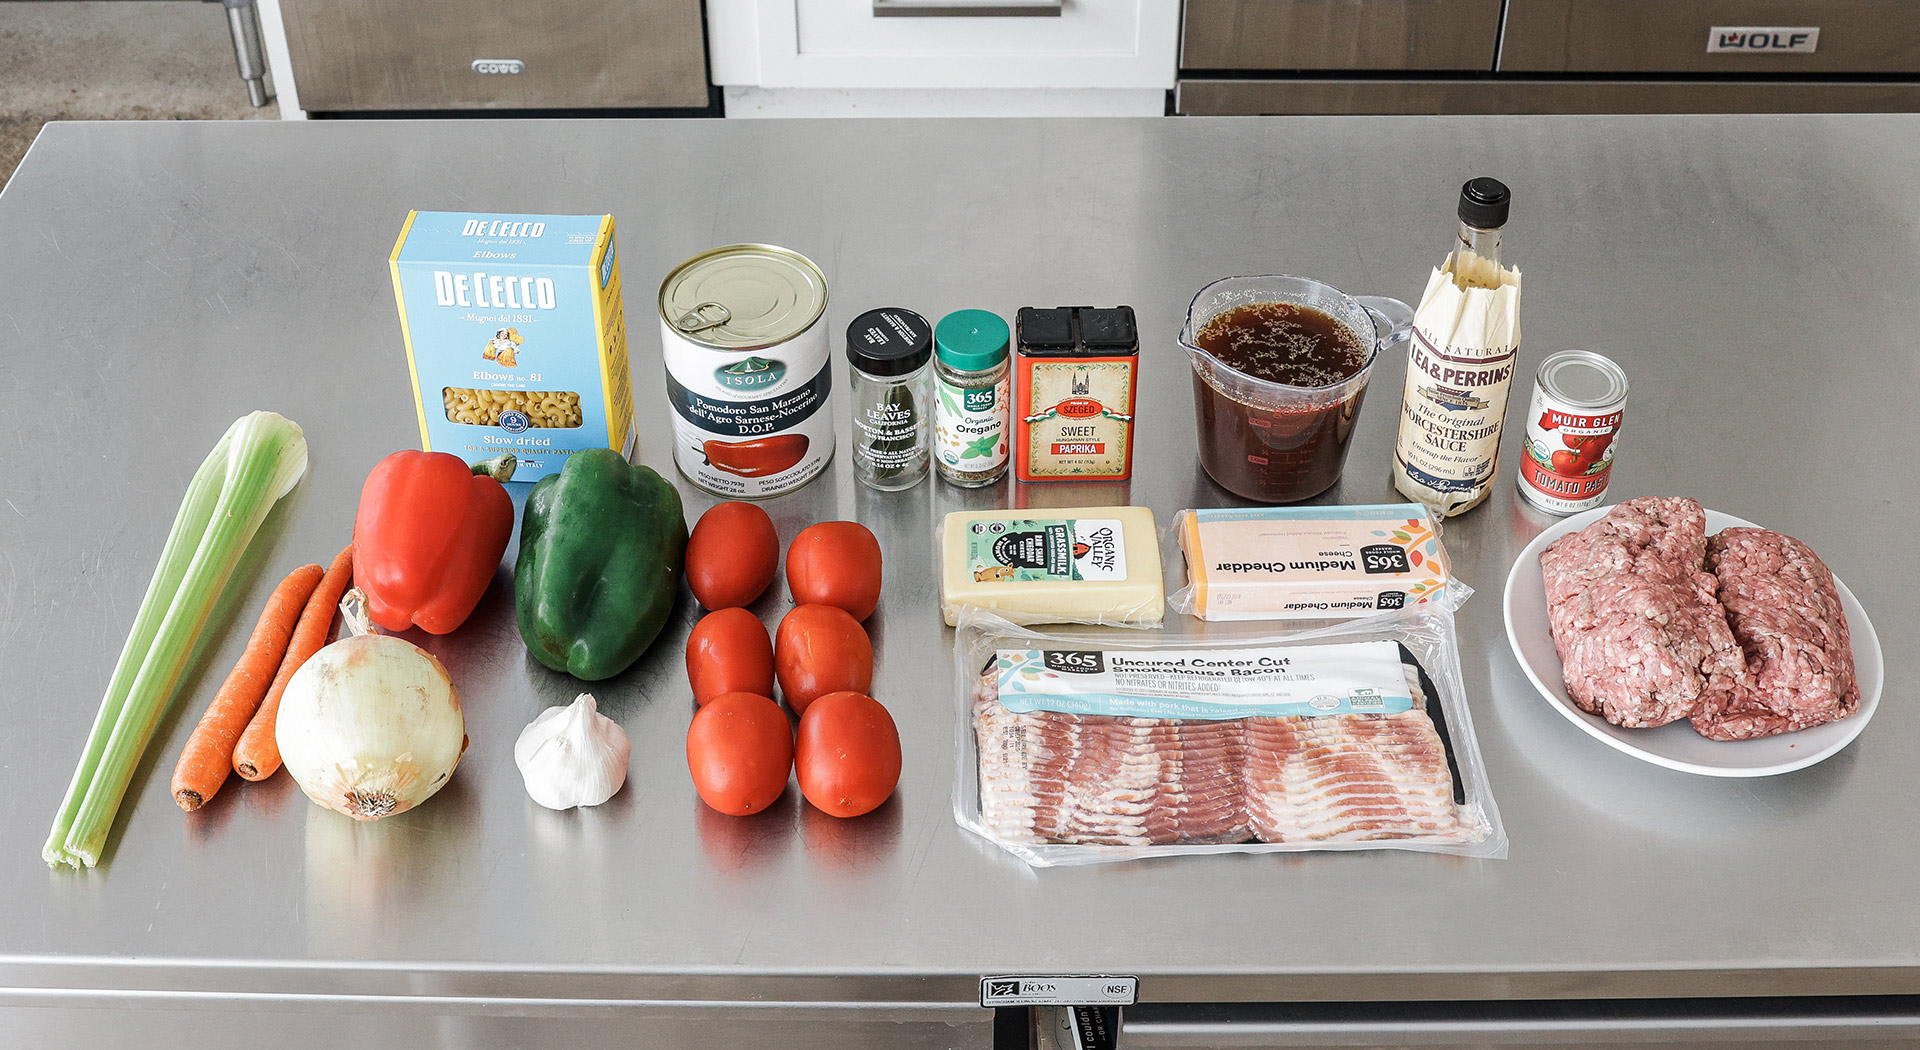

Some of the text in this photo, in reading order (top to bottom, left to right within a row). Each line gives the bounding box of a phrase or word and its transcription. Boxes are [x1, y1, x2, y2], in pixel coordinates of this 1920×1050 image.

[1720, 33, 1808, 48] WOLF
[488, 220, 546, 238] CECCO
[472, 250, 517, 259] Elbows
[473, 272, 556, 310] CECCO
[466, 313, 532, 325] Mugnai dal 1831
[1422, 328, 1511, 357] ALL NATURAL
[473, 372, 514, 381] Elbows
[530, 373, 542, 382] 81
[726, 372, 777, 386] ISOLA
[696, 389, 811, 415] Pomodoro San Marzano
[966, 391, 993, 405] 365
[866, 408, 911, 421] LEAVES
[876, 403, 901, 412] BAY
[1064, 406, 1095, 414] SZEGED
[510, 416, 517, 424] 9
[869, 418, 909, 427] CALIFORNIA
[965, 416, 994, 426] Organic
[1404, 400, 1500, 441] WORCESTERSHIRE
[1418, 402, 1485, 429] The Original
[1552, 413, 1621, 428] MUIR GLEN
[739, 422, 775, 434] D.O.P.
[855, 417, 884, 436] MORTON
[957, 420, 1002, 435] Oregano
[1061, 426, 1096, 436] SWEET
[483, 436, 551, 446] Slow dried
[864, 432, 915, 441] SAN FRANCISCO
[1424, 434, 1467, 453] SAUCE
[1059, 444, 1096, 454] PAPRIKA
[1412, 440, 1439, 459] Unwrap
[1420, 460, 1428, 468] OZ
[1428, 464, 1442, 474] (296
[706, 480, 729, 492] WEIGHT
[712, 476, 730, 486] NETTO
[730, 481, 745, 490] 793g
[762, 472, 809, 493] DRAINED WEIGHT
[1535, 469, 1581, 495] TOMATO
[1025, 538, 1035, 563] CHEDDAR
[1035, 548, 1044, 565] SHARP
[1054, 527, 1068, 575] GRASSMILK
[1089, 530, 1104, 569] VALLEY
[1099, 527, 1116, 572] ORGANIC
[1318, 550, 1353, 558] Cheese
[1216, 560, 1356, 574] Medium Cheddar
[1368, 554, 1404, 570] 365
[1284, 601, 1373, 610] Medium Cheddar
[1380, 597, 1403, 608] 365
[1050, 652, 1097, 667] 365
[1112, 657, 1291, 667] Uncured Center Cut
[1112, 667, 1286, 677] Smokehouse Bacon
[1126, 680, 1157, 689] NITRATES
[1158, 681, 1167, 689] OR
[1168, 682, 1196, 691] NITRITES
[1198, 684, 1222, 692] ADDED!
[1020, 698, 1033, 706] NET
[1034, 698, 1046, 706] WT
[1046, 699, 1054, 707] 12
[1067, 700, 1092, 710] (340g)
[1137, 700, 1157, 708] with
[1160, 702, 1179, 711] pork
[1182, 704, 1200, 712] that
[1023, 983, 1056, 992] BOOS
